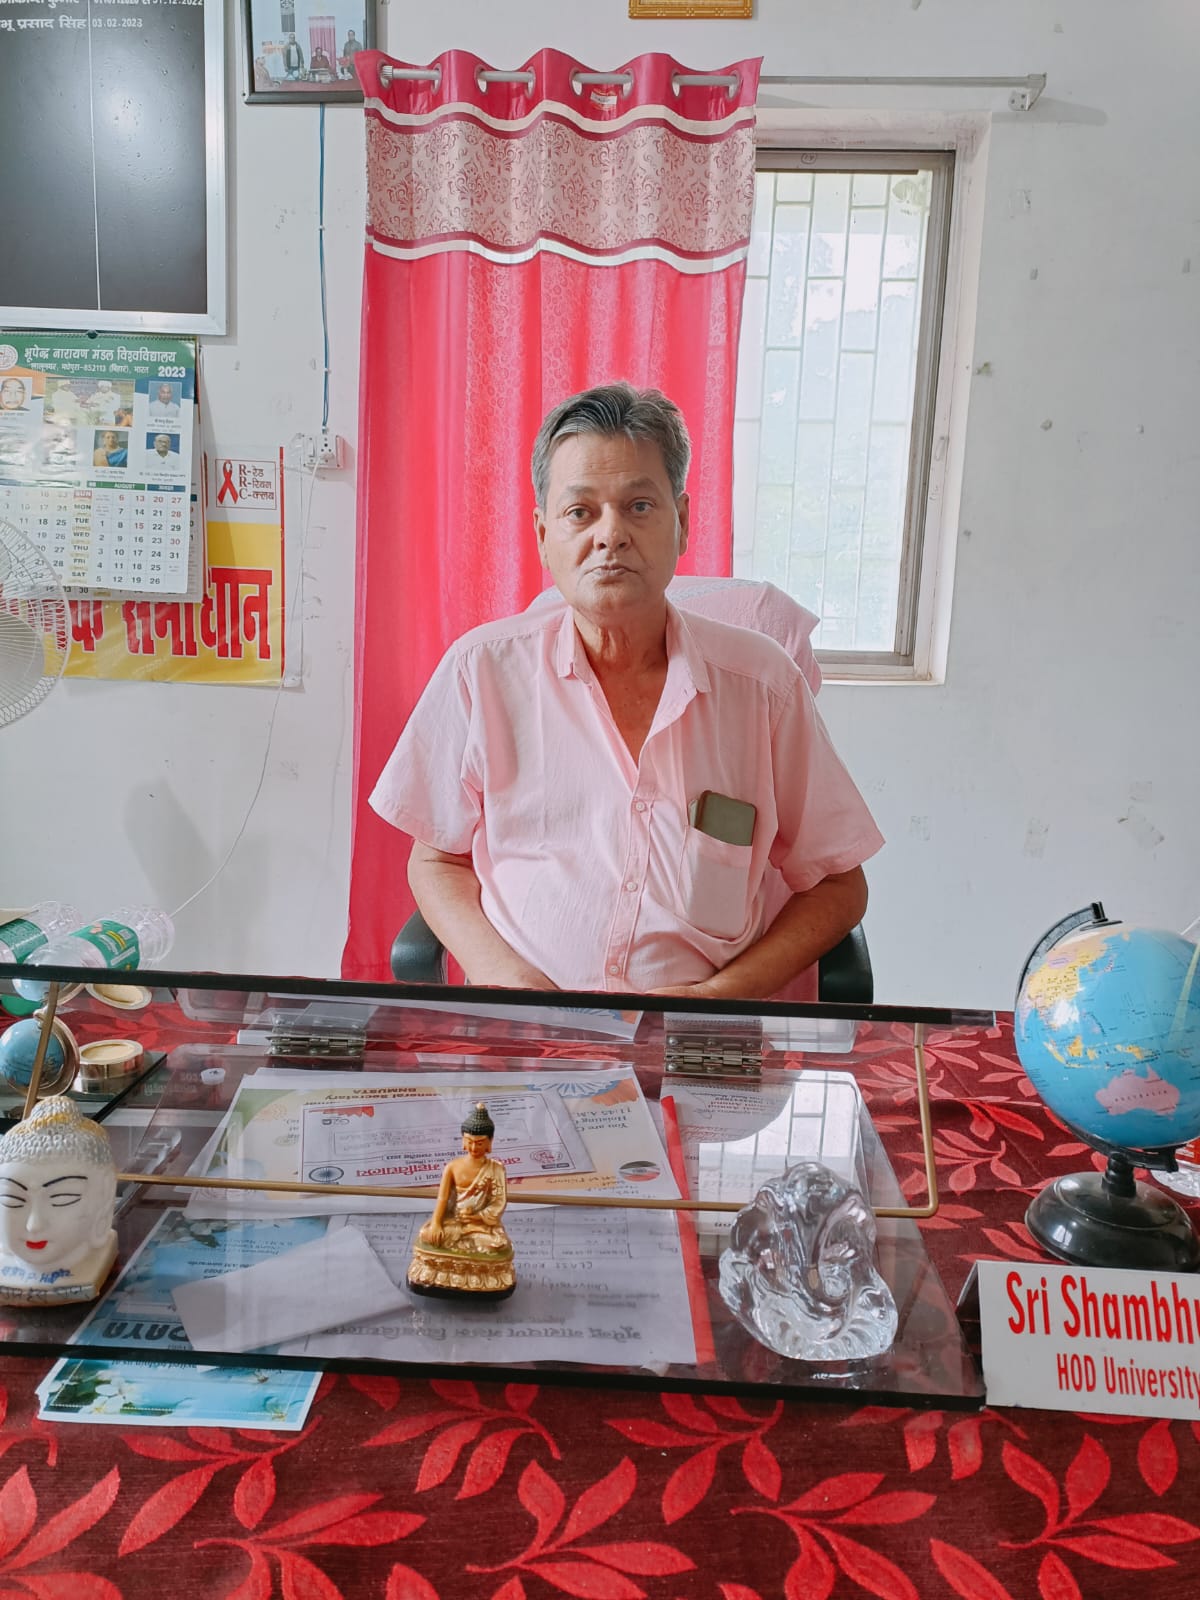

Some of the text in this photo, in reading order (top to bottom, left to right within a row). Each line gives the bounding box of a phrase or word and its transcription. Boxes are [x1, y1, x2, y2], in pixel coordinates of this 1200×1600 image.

[17, 18, 54, 29] प्रसाद
[59, 15, 86, 28] सिंह
[92, 18, 143, 28] 03.02.2023
[24, 345, 177, 364] भूपेन्द्र नारायण मंडल विश्वविद्यालय
[158, 366, 186, 378] 2023
[114, 482, 136, 490] AUGUST
[135, 508, 145, 516] 14
[152, 509, 163, 517] 21
[1006, 1271, 1050, 1335] Sri
[1057, 1353, 1096, 1392] HOD
